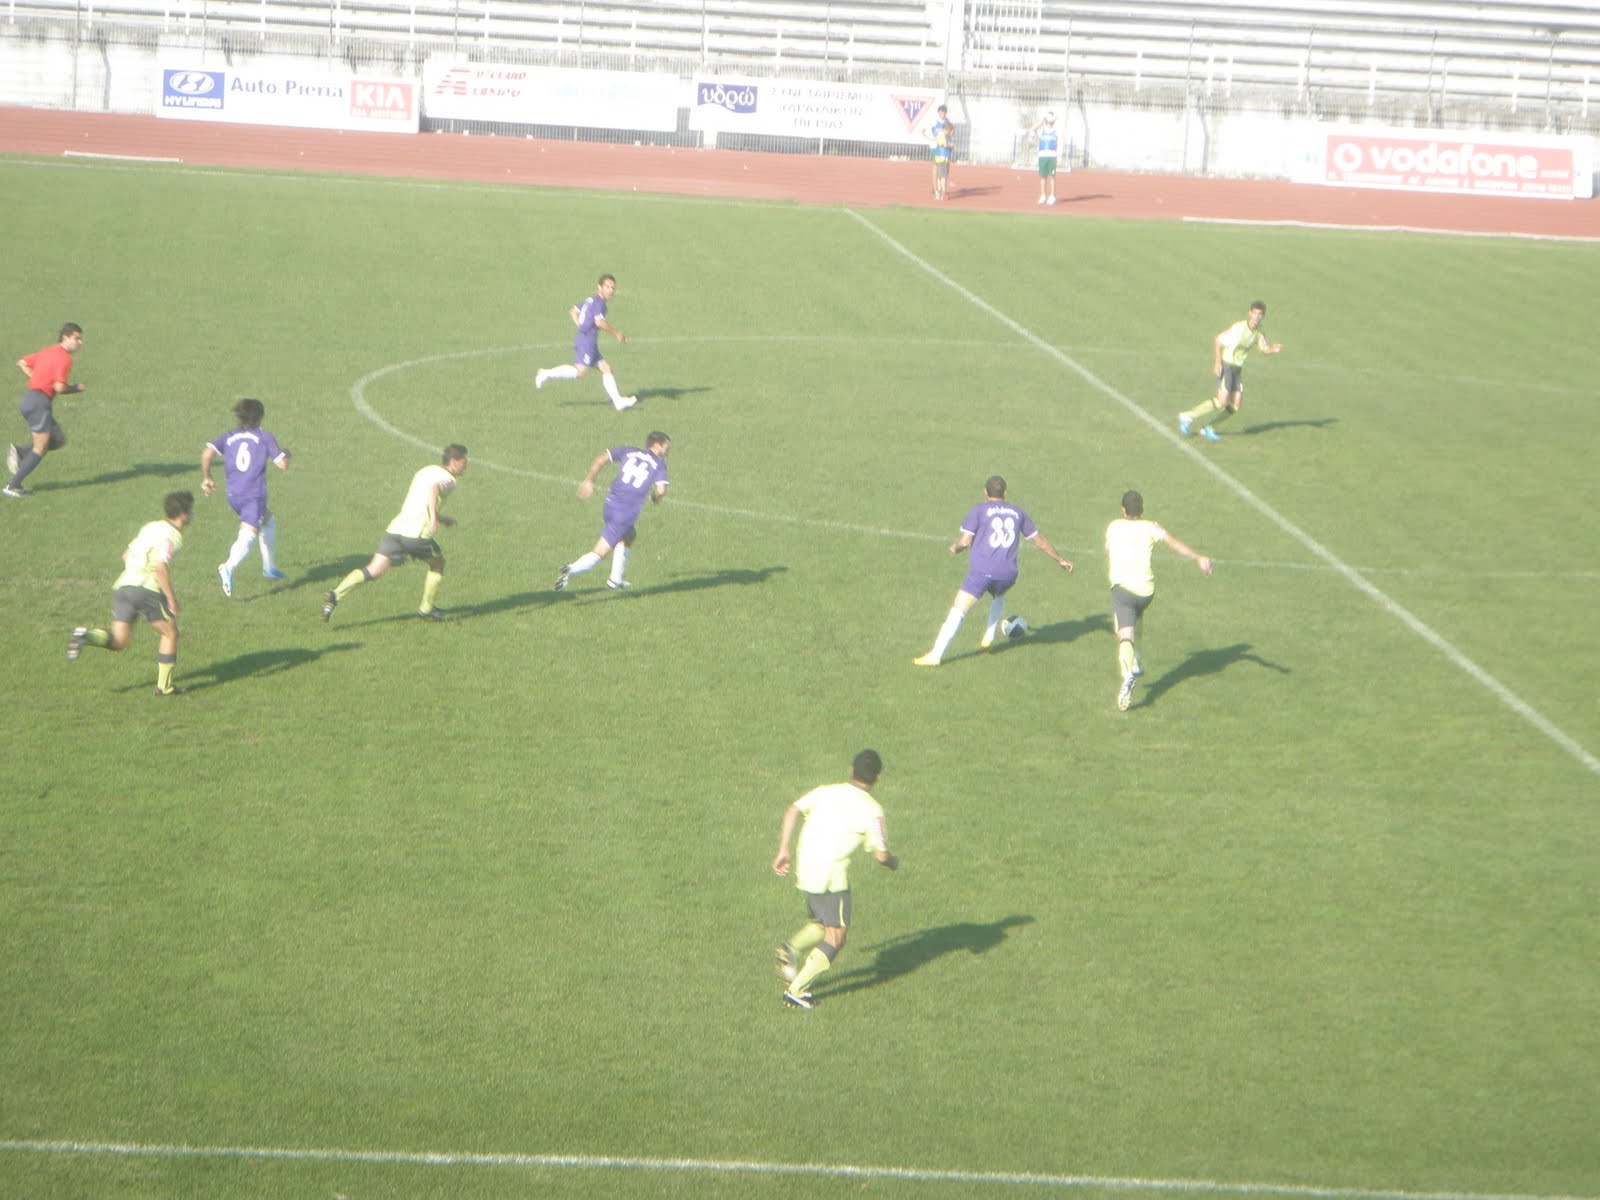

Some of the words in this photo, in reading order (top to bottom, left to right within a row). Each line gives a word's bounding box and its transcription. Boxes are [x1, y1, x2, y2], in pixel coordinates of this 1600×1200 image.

[231, 77, 277, 94] Auto
[356, 84, 404, 108] KIA
[164, 95, 221, 108] HYUNDAI
[1370, 143, 1538, 179] vodafone
[236, 441, 251, 473] 6
